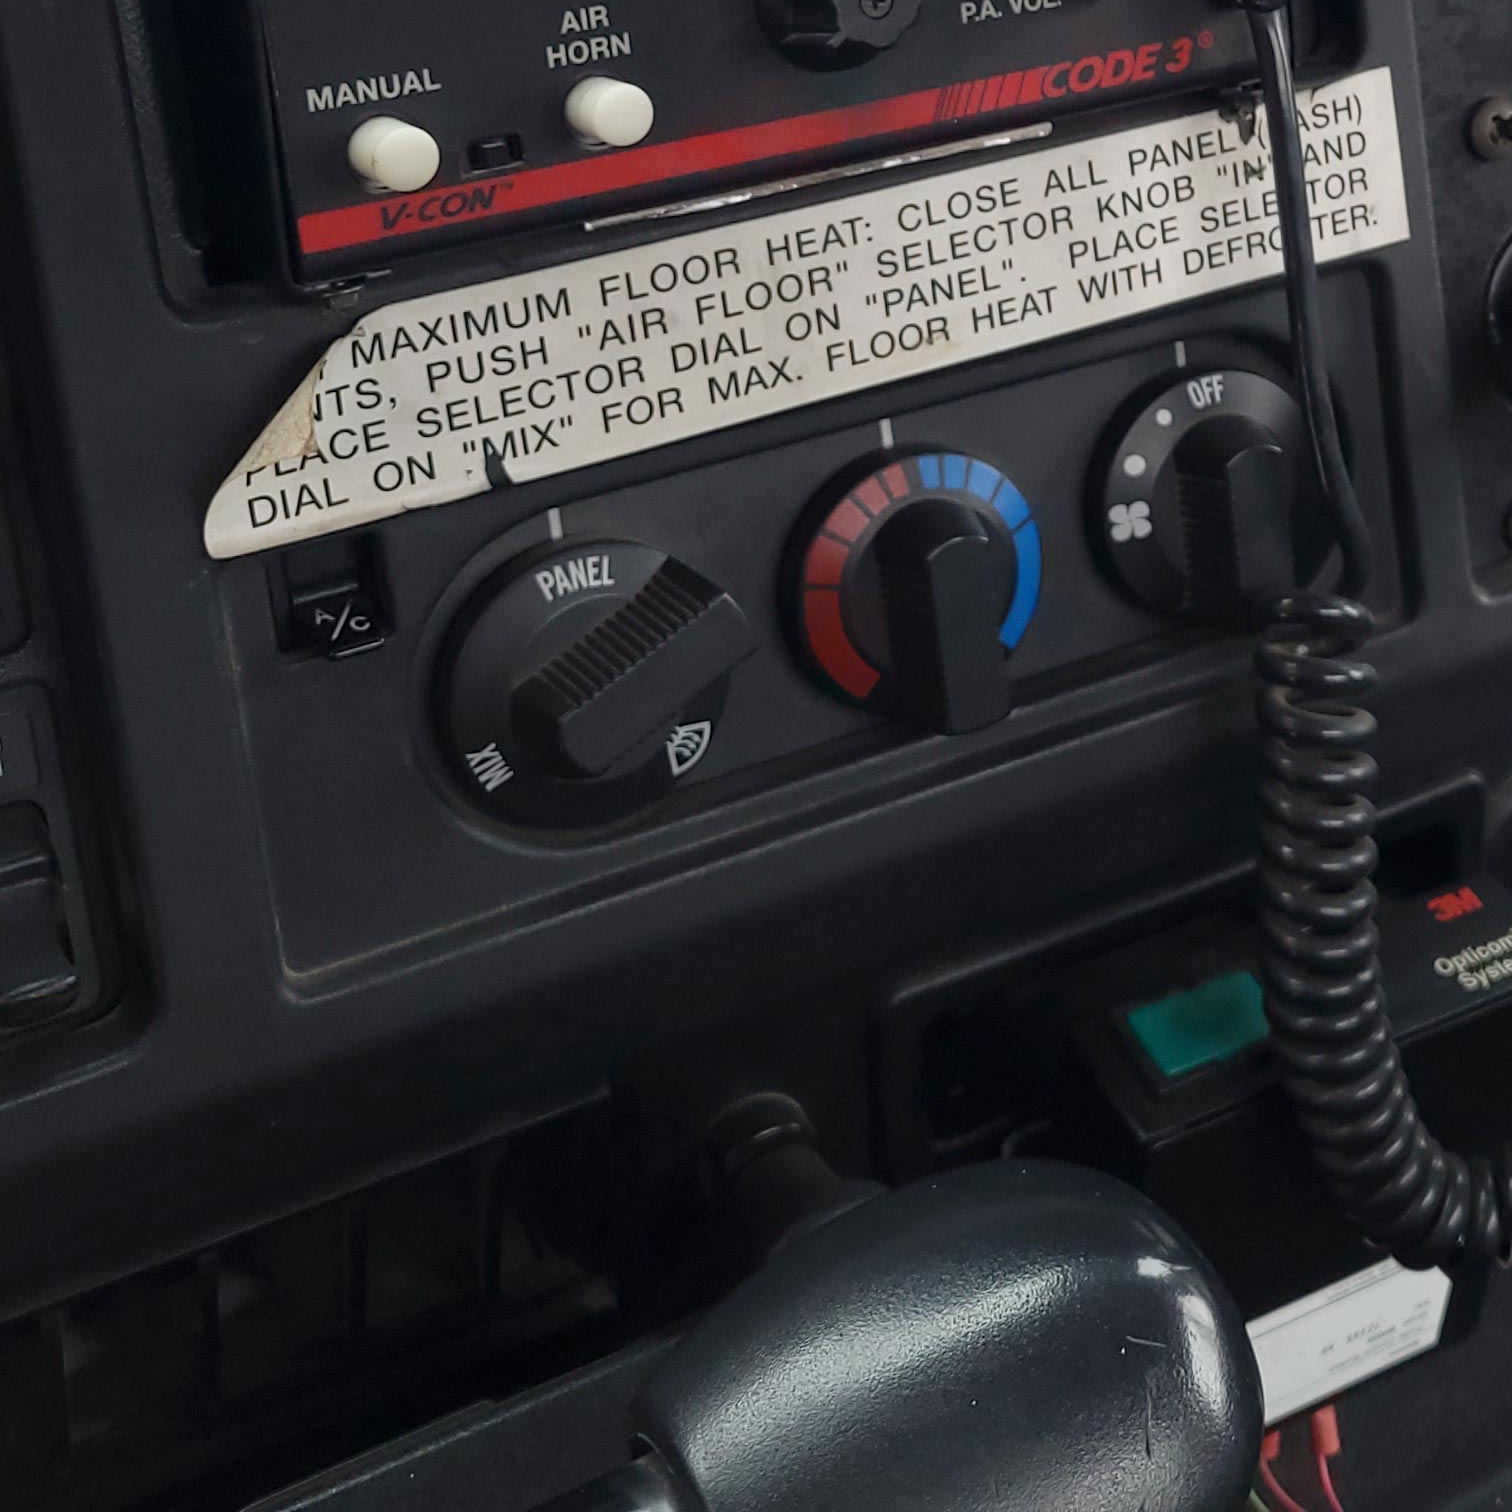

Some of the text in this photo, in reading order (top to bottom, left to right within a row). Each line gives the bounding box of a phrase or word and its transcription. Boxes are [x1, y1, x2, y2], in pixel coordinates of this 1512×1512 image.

[560, 5, 610, 35] AIR
[546, 33, 631, 68] HORN
[1042, 43, 1163, 98] CODE
[306, 69, 441, 112] MANUAL
[351, 288, 571, 368] MAXIMUM
[600, 248, 741, 306] FLOOR
[767, 217, 873, 266] HEAT:
[899, 179, 1022, 232] CLOSE
[1044, 160, 1108, 196] ALL
[1128, 127, 1237, 172] PANEL
[427, 337, 549, 393] PUSH
[579, 308, 668, 350] "AIR
[697, 261, 848, 325] FLOOR"
[878, 207, 1073, 279] SELECTOR
[1098, 176, 1196, 223] KNOB
[1303, 131, 1367, 168] AND
[417, 356, 645, 438] SELECTOR
[672, 326, 763, 373] DIAL
[786, 304, 841, 342] ON
[866, 257, 1027, 318] "PANEL".
[1069, 219, 1178, 269] PLACE
[1201, 167, 1368, 233] SELETOR
[247, 203, 1378, 528] DIAL ON "MIX" FOR MAX. FLOOR HEAT WITH DEFROTER.
[1186, 374, 1225, 408] OFF
[535, 555, 615, 602] PANEL
[314, 599, 371, 641] A/C
[466, 743, 514, 791] MIX
[1427, 886, 1483, 922] 3M
